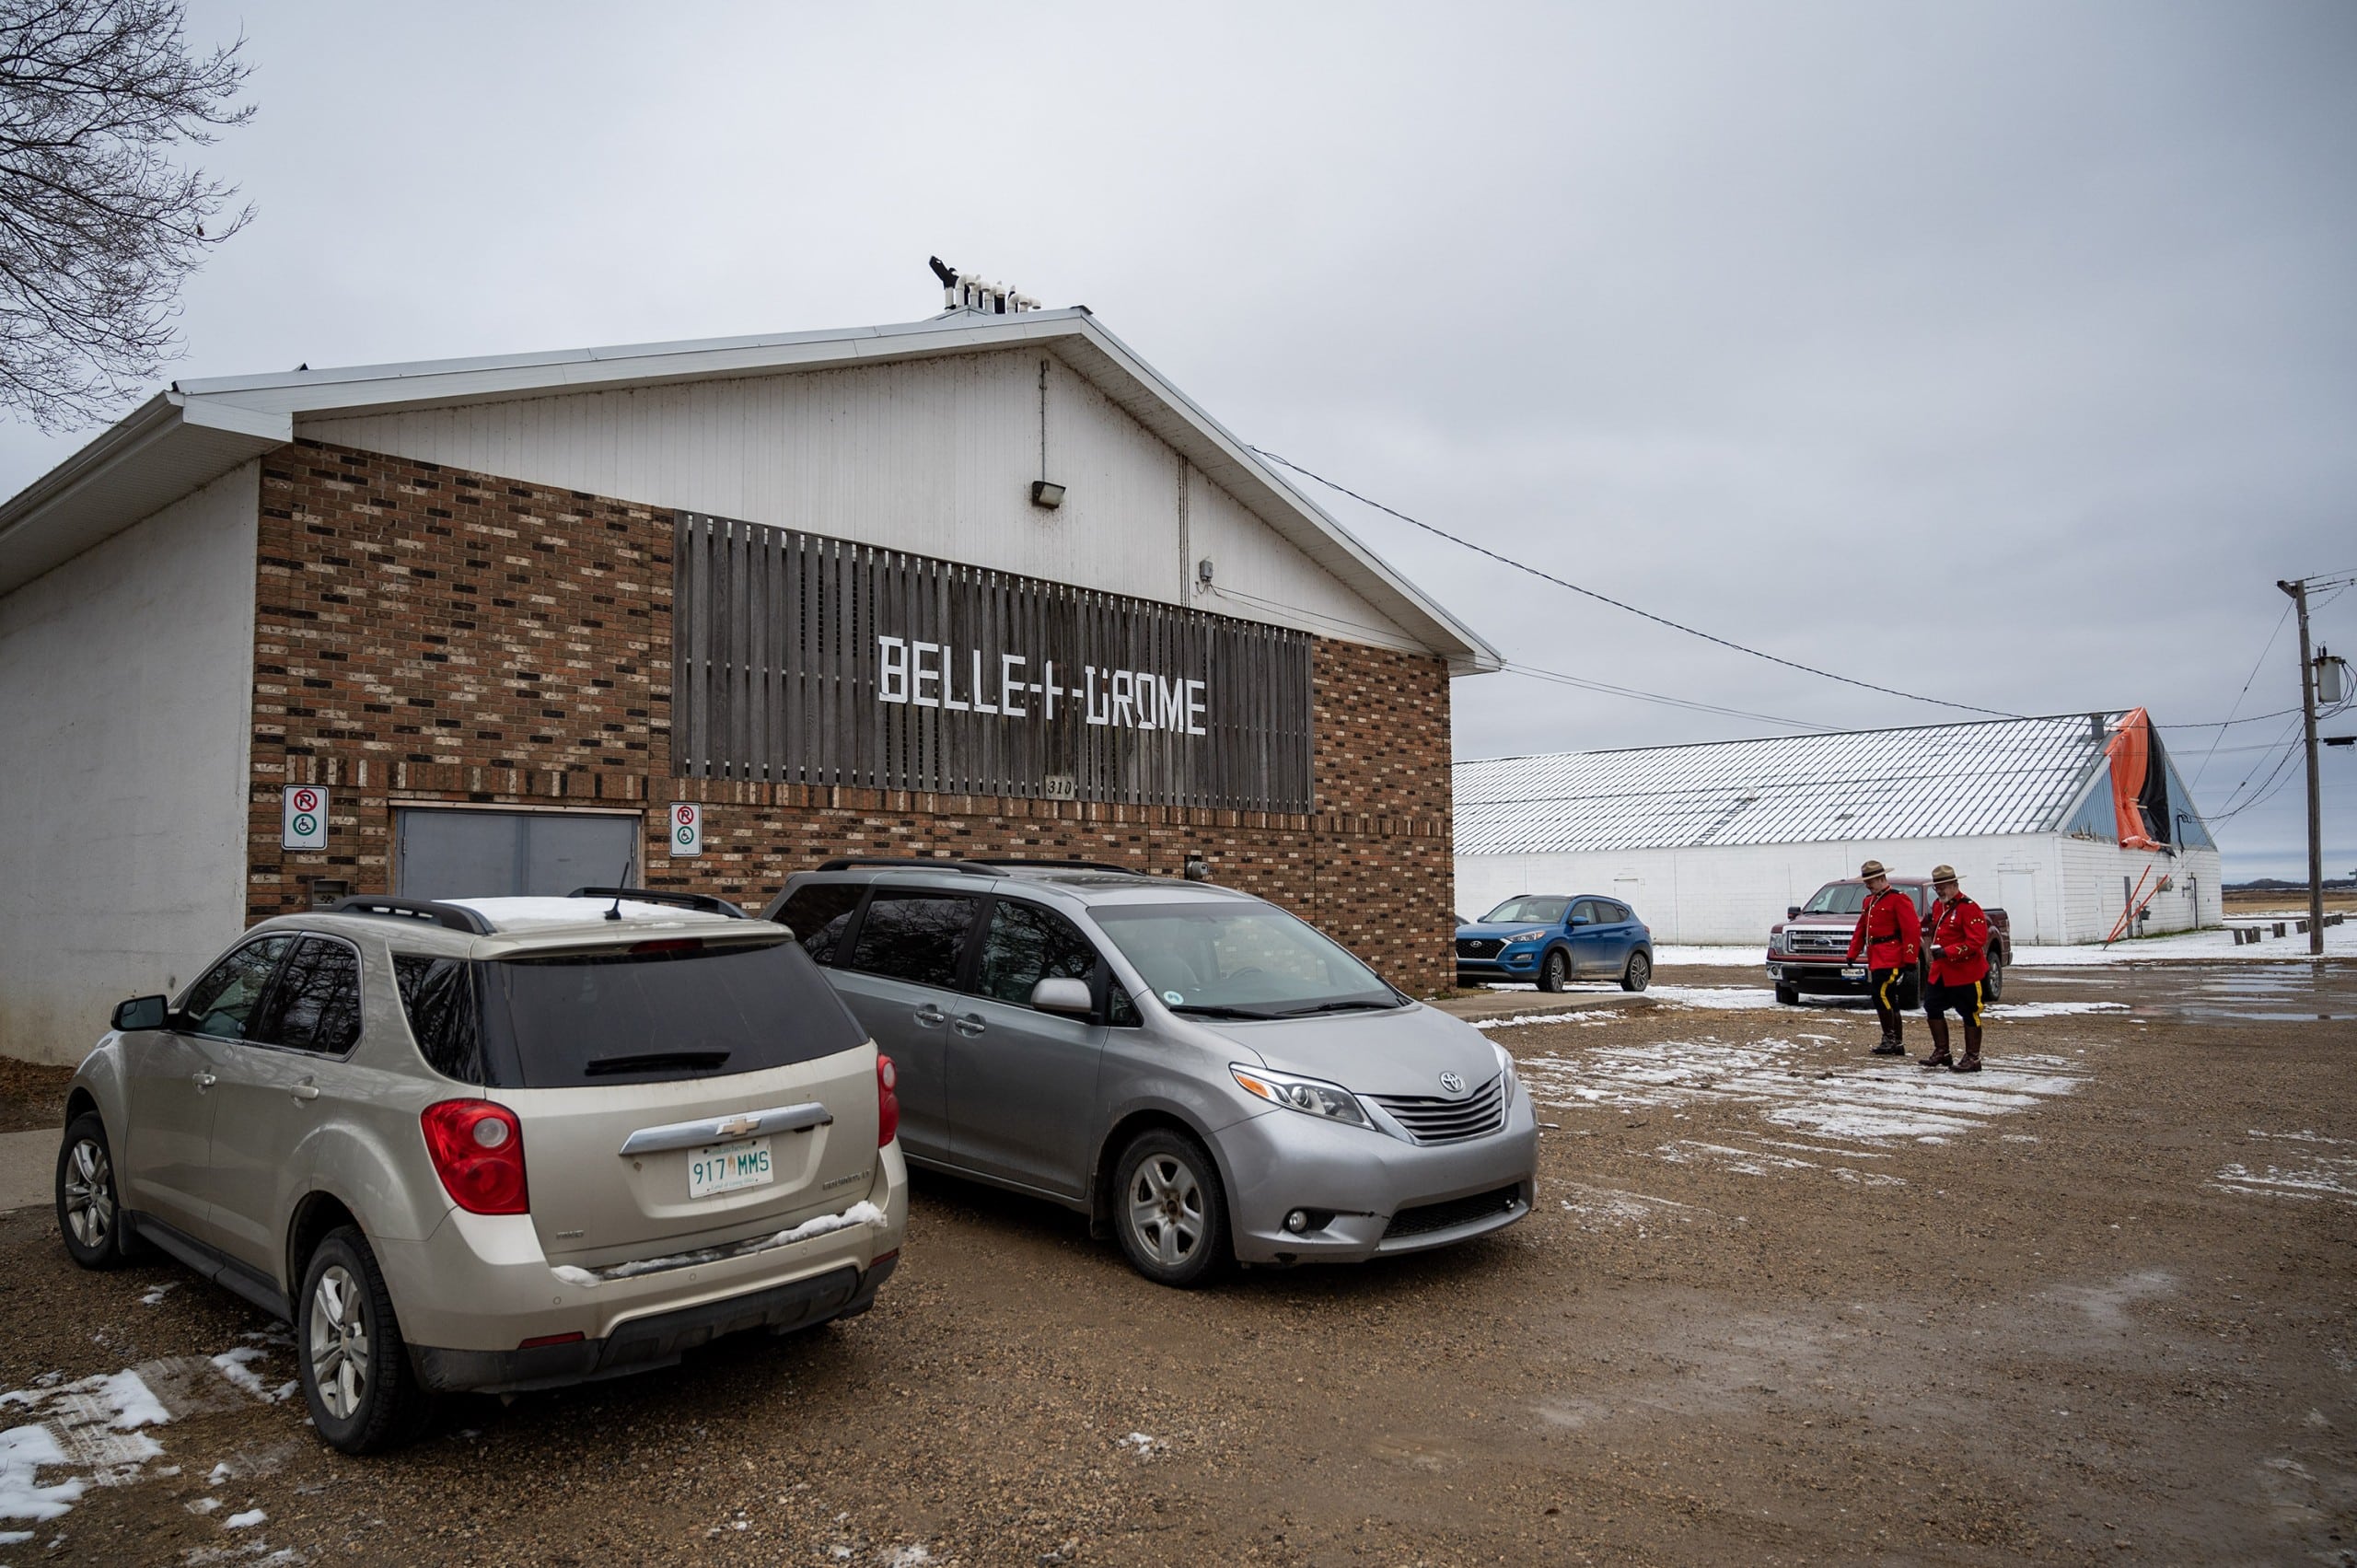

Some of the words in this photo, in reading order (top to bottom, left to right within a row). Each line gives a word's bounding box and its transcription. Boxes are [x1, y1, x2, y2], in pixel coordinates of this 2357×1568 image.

[1048, 780, 1072, 795] 310
[693, 1158, 726, 1185] 917
[737, 1150, 769, 1176] MMS
